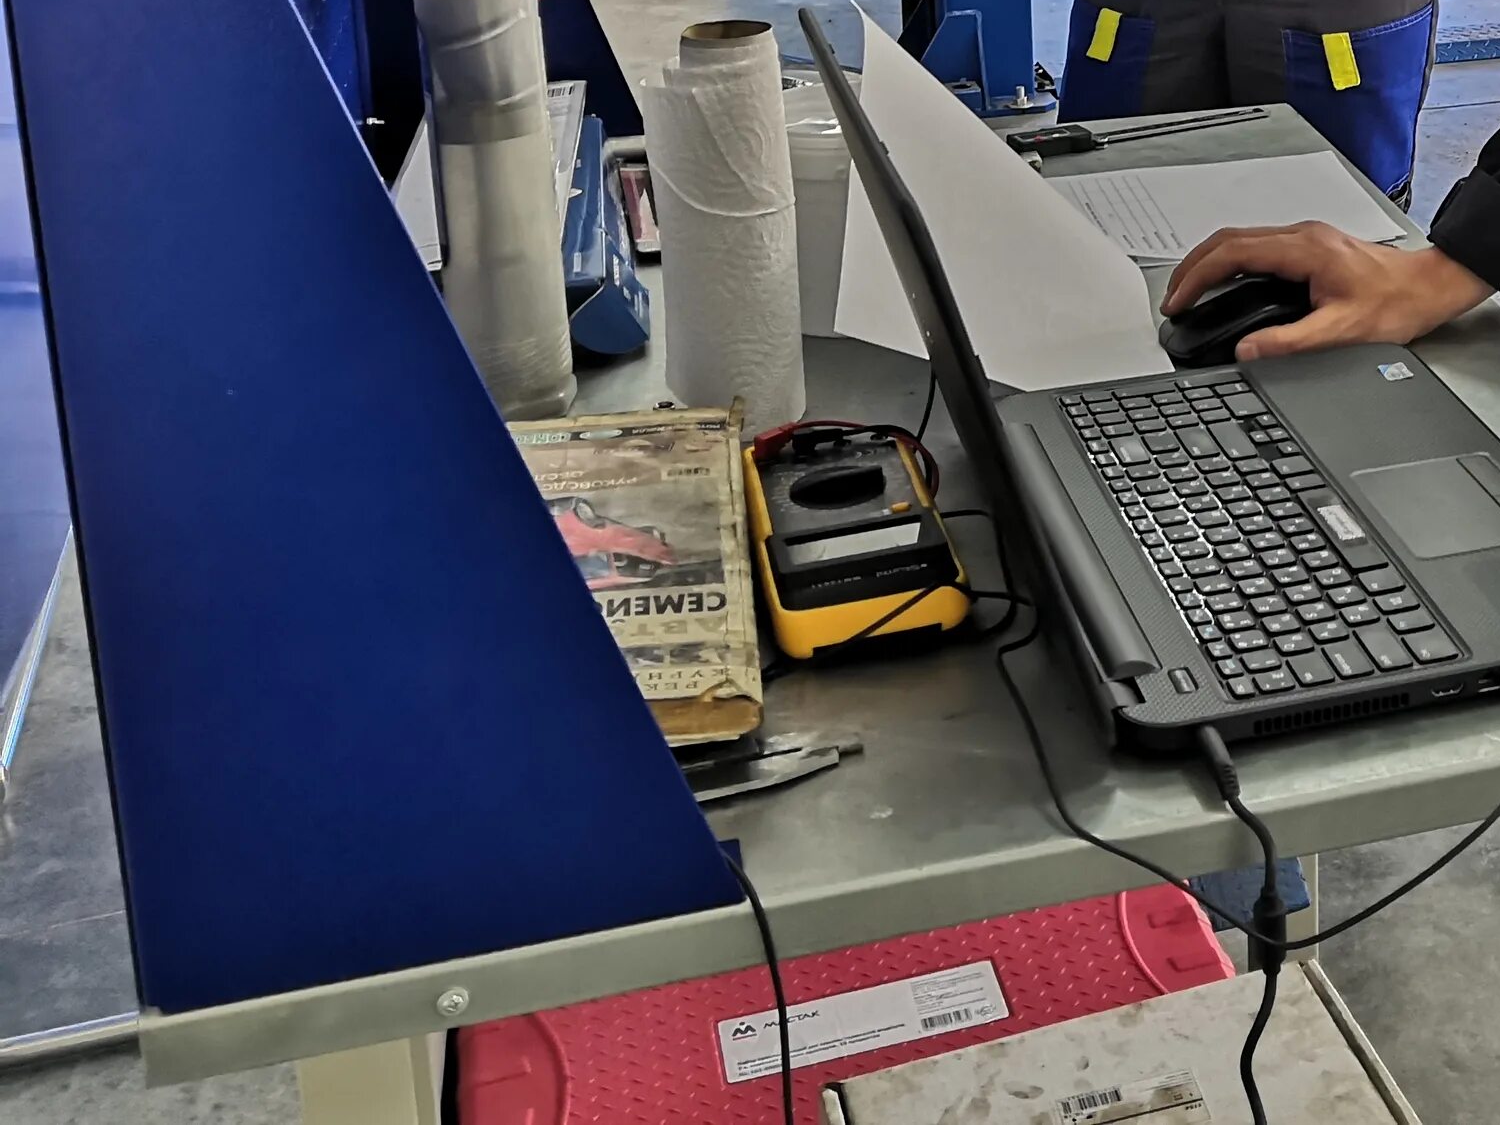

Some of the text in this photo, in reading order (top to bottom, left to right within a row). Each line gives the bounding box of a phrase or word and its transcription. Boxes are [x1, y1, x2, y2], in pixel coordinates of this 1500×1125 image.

[594, 591, 727, 624] СЕМЕЙ
[634, 666, 730, 681] ЖУРН
[763, 1010, 819, 1029] МСТАК
